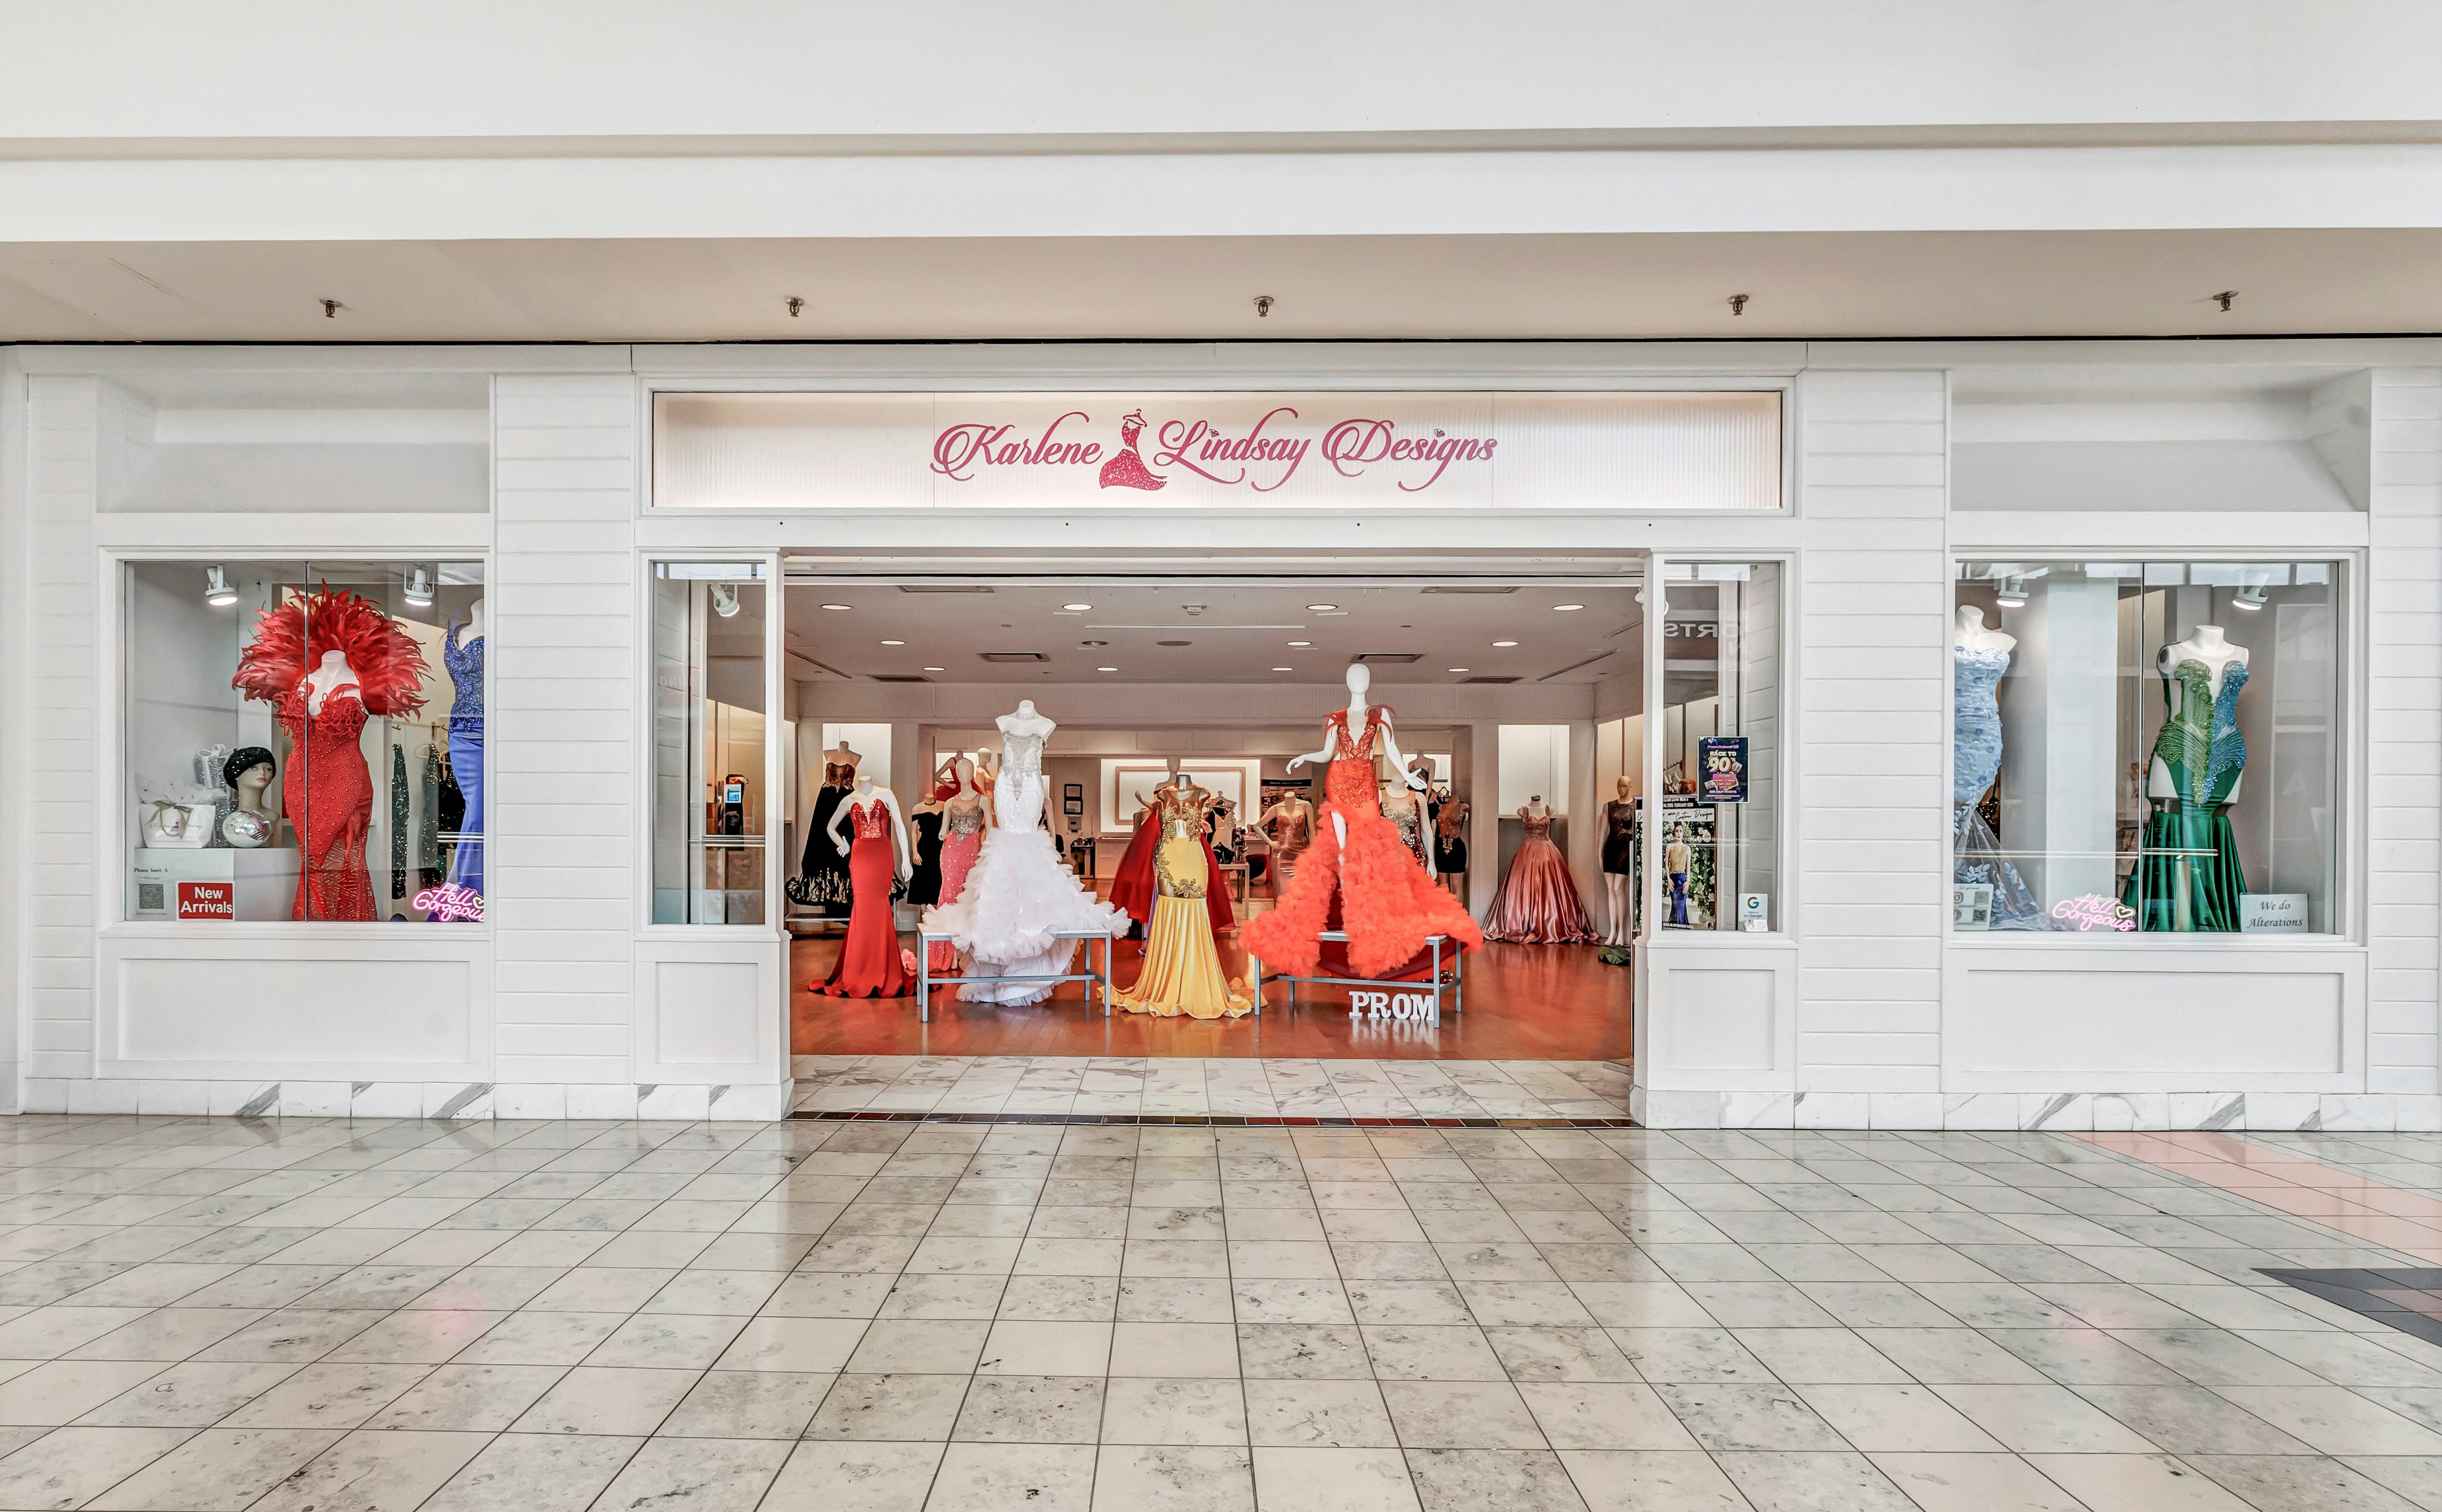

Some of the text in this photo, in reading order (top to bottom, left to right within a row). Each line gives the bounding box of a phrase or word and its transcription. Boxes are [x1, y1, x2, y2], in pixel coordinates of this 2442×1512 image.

[930, 407, 1497, 491] Karlene Lindsay Designs
[194, 886, 223, 899] New
[180, 900, 233, 914] Arrivals
[2259, 900, 2291, 910] We do
[2052, 900, 2135, 931] Gorgeous
[2246, 917, 2303, 928] Alterations
[1349, 991, 1434, 1021] PROM
